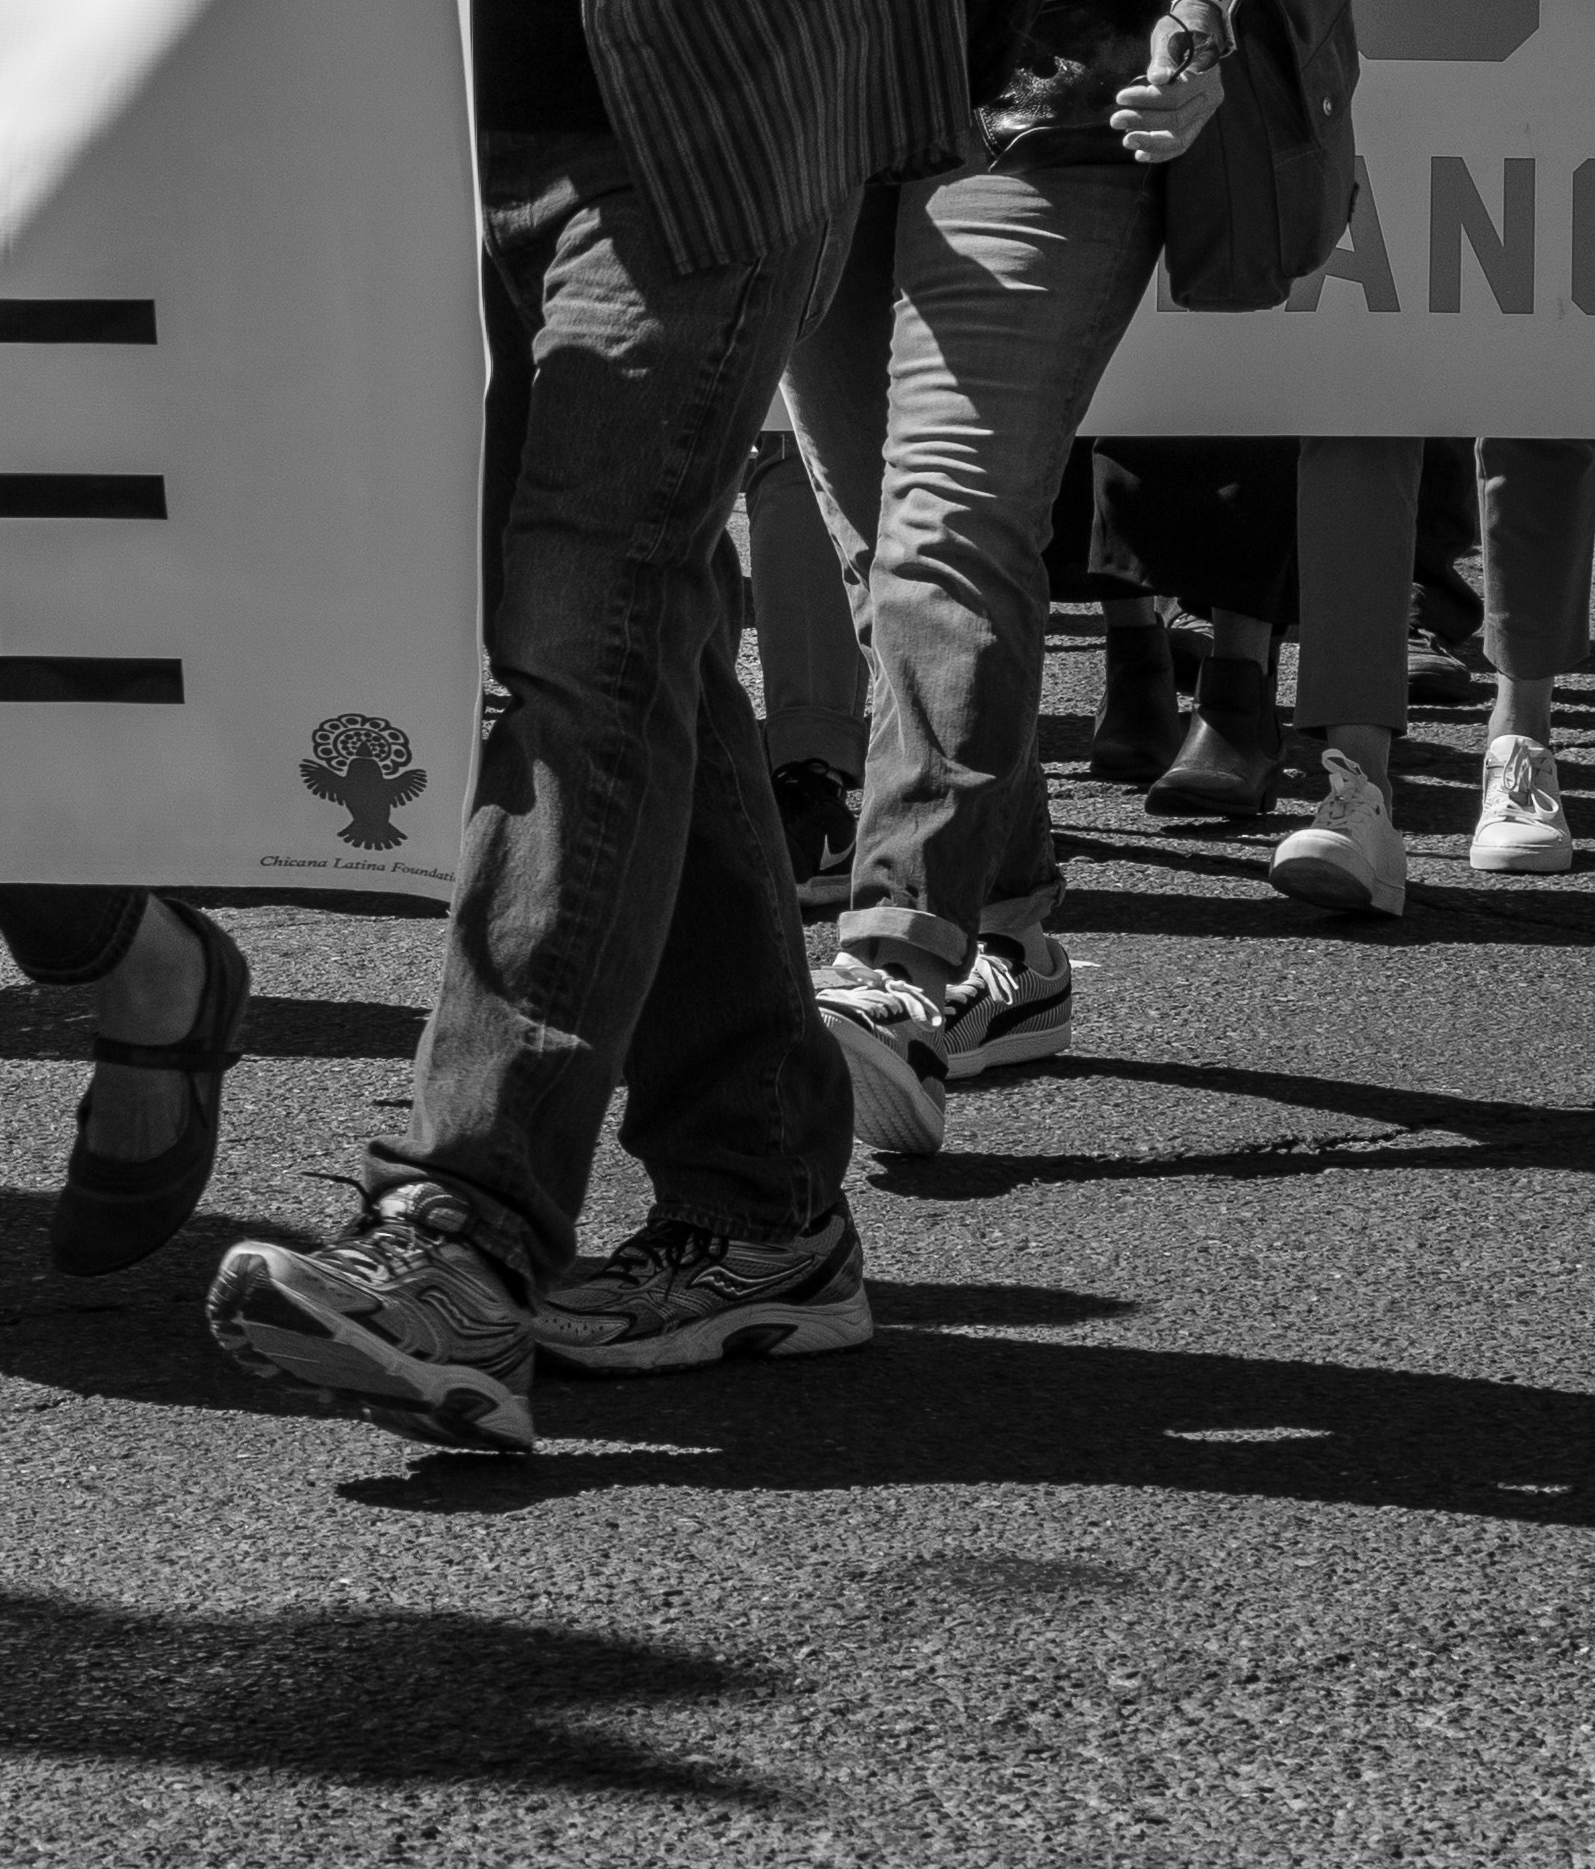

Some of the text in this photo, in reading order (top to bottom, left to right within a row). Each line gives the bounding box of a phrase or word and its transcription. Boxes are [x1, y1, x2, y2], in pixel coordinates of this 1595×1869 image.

[259, 855, 457, 882] Chicana Latina Foundati
